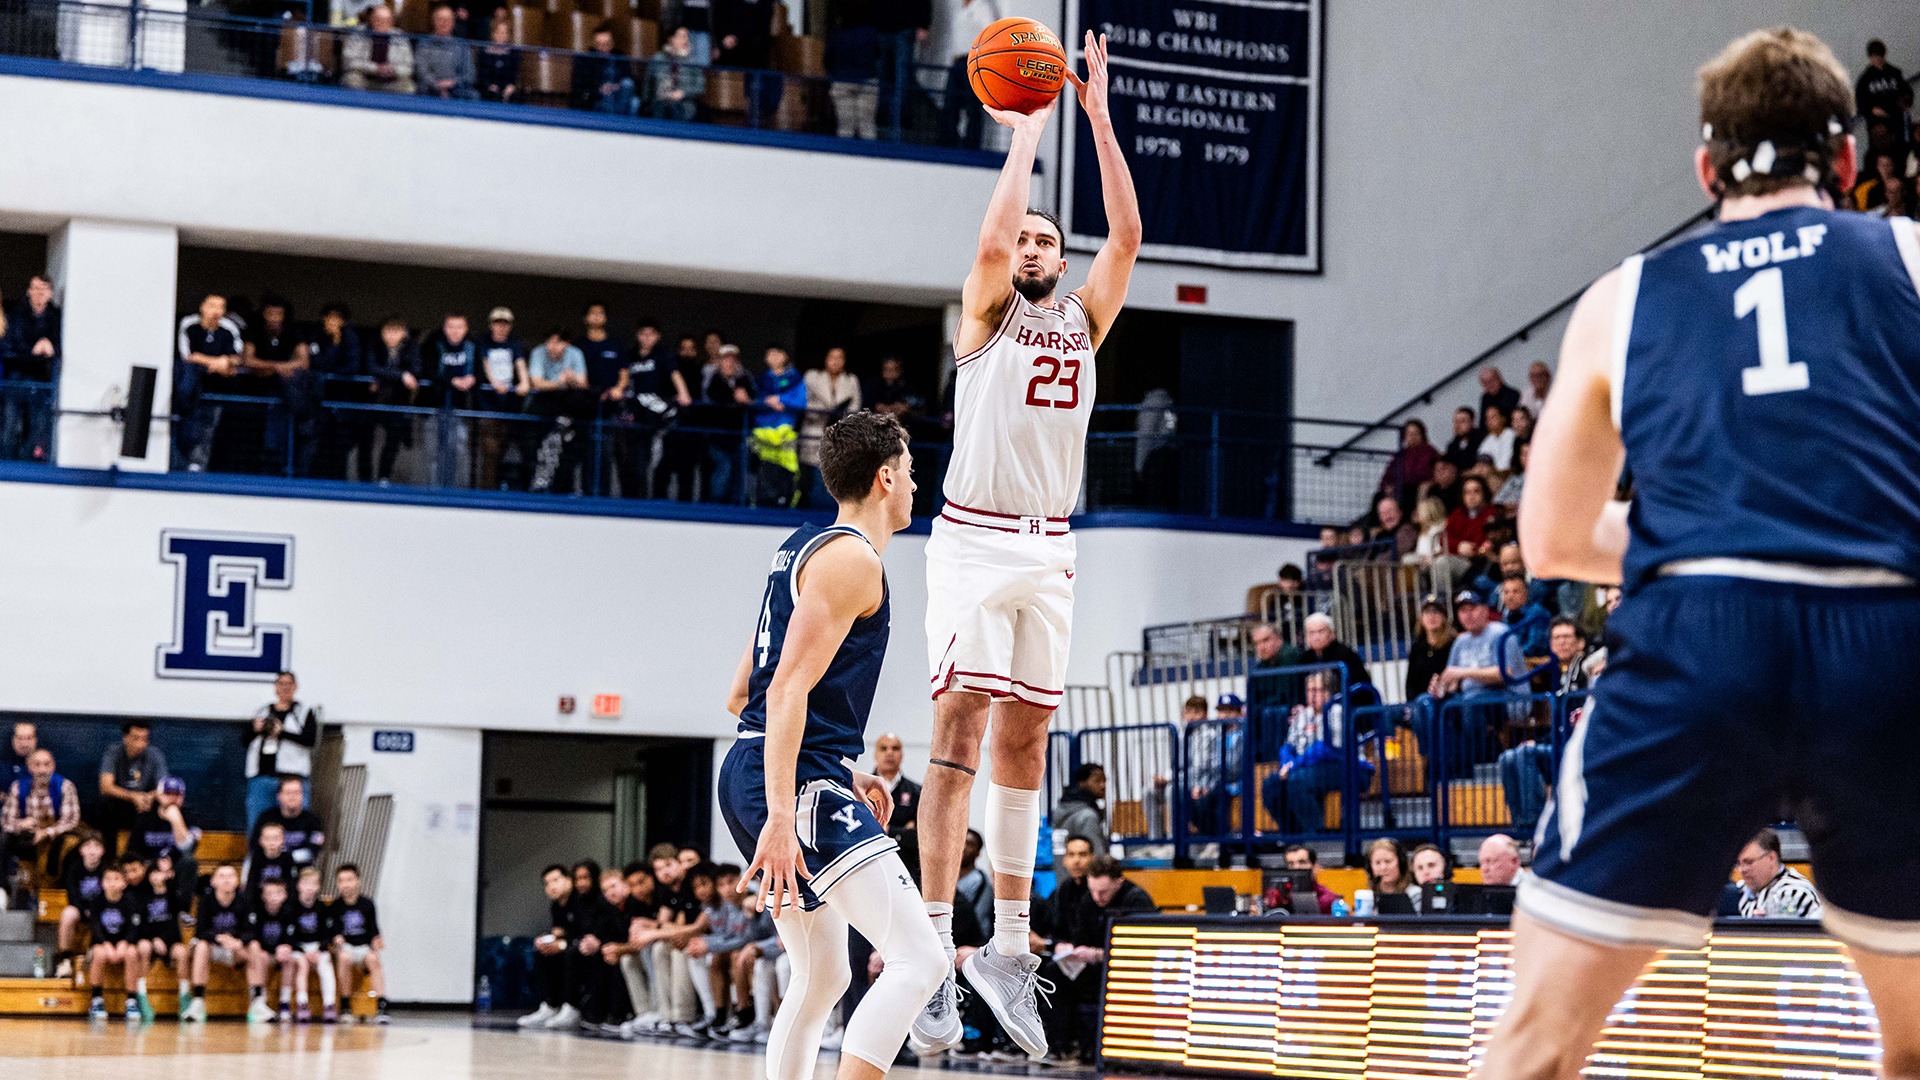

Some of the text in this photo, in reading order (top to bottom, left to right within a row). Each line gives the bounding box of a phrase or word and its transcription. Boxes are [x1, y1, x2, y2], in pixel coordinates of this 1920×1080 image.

[1172, 8, 1217, 32] WBI
[1010, 31, 1063, 50] SPALD
[1101, 22, 1290, 63] 2018 CHAMPIONS
[1016, 57, 1064, 75] LEGACY
[1111, 75, 1276, 112] AIAW EASTERN
[1137, 103, 1250, 134] REGIONAL
[1136, 135, 1250, 165] 1978 1979
[1701, 223, 1828, 273] WOLF
[1015, 325, 1089, 355] HARARD
[1733, 266, 1810, 396] 1
[1025, 355, 1081, 409] 23
[1029, 519, 1041, 534] H
[155, 527, 296, 683] E
[830, 803, 863, 834] Y
